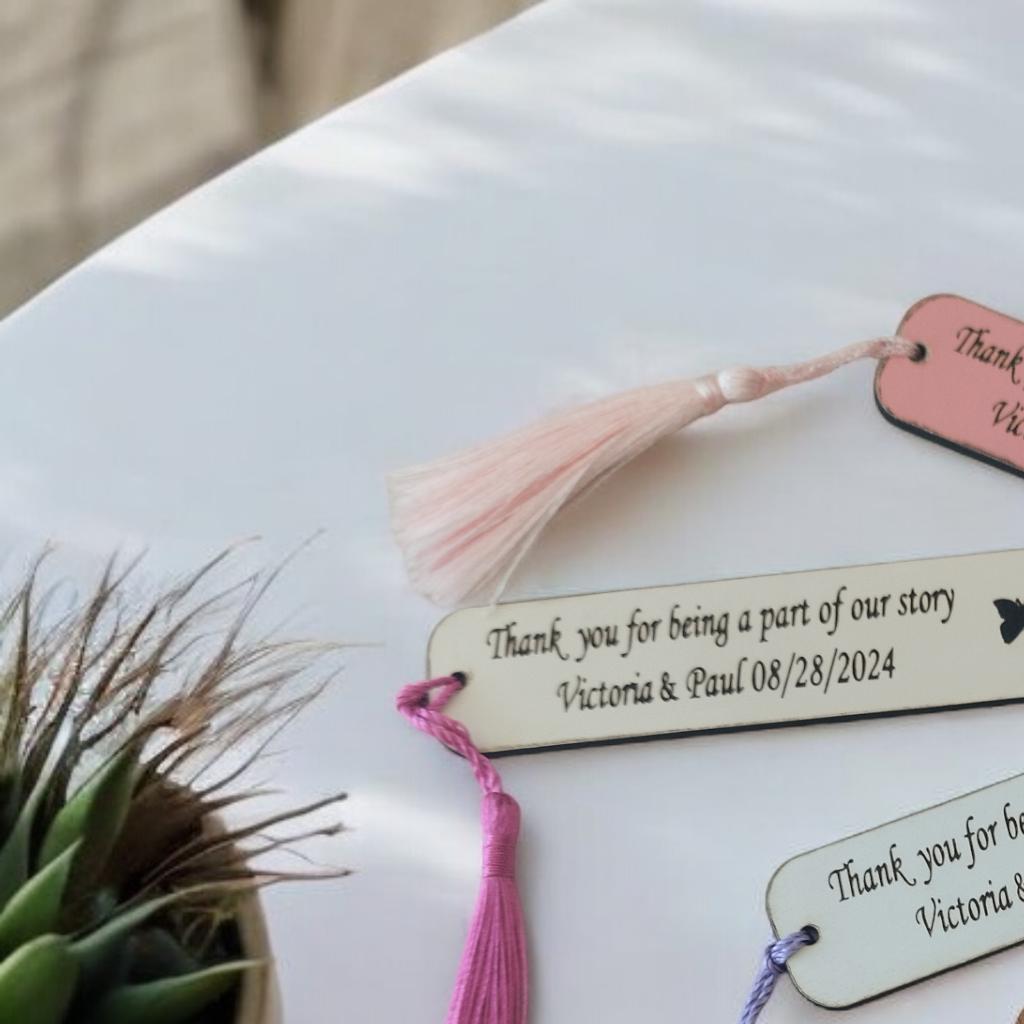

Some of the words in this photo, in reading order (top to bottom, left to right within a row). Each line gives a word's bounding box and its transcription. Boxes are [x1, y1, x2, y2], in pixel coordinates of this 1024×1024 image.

[486, 617, 570, 661] Thank
[575, 625, 619, 663] you
[620, 608, 662, 658] for
[669, 604, 730, 647] being
[738, 610, 752, 633] a
[759, 599, 811, 643] part
[819, 586, 847, 636] of
[851, 594, 891, 621] our
[897, 588, 955, 624] story
[556, 672, 654, 712] Victoria
[659, 671, 680, 702] &
[686, 657, 748, 699] Paul
[751, 647, 896, 699] 08/28/2024
[828, 843, 917, 902] Thank
[917, 838, 961, 885] you
[964, 816, 997, 870] for
[915, 880, 1013, 937] Victoria
